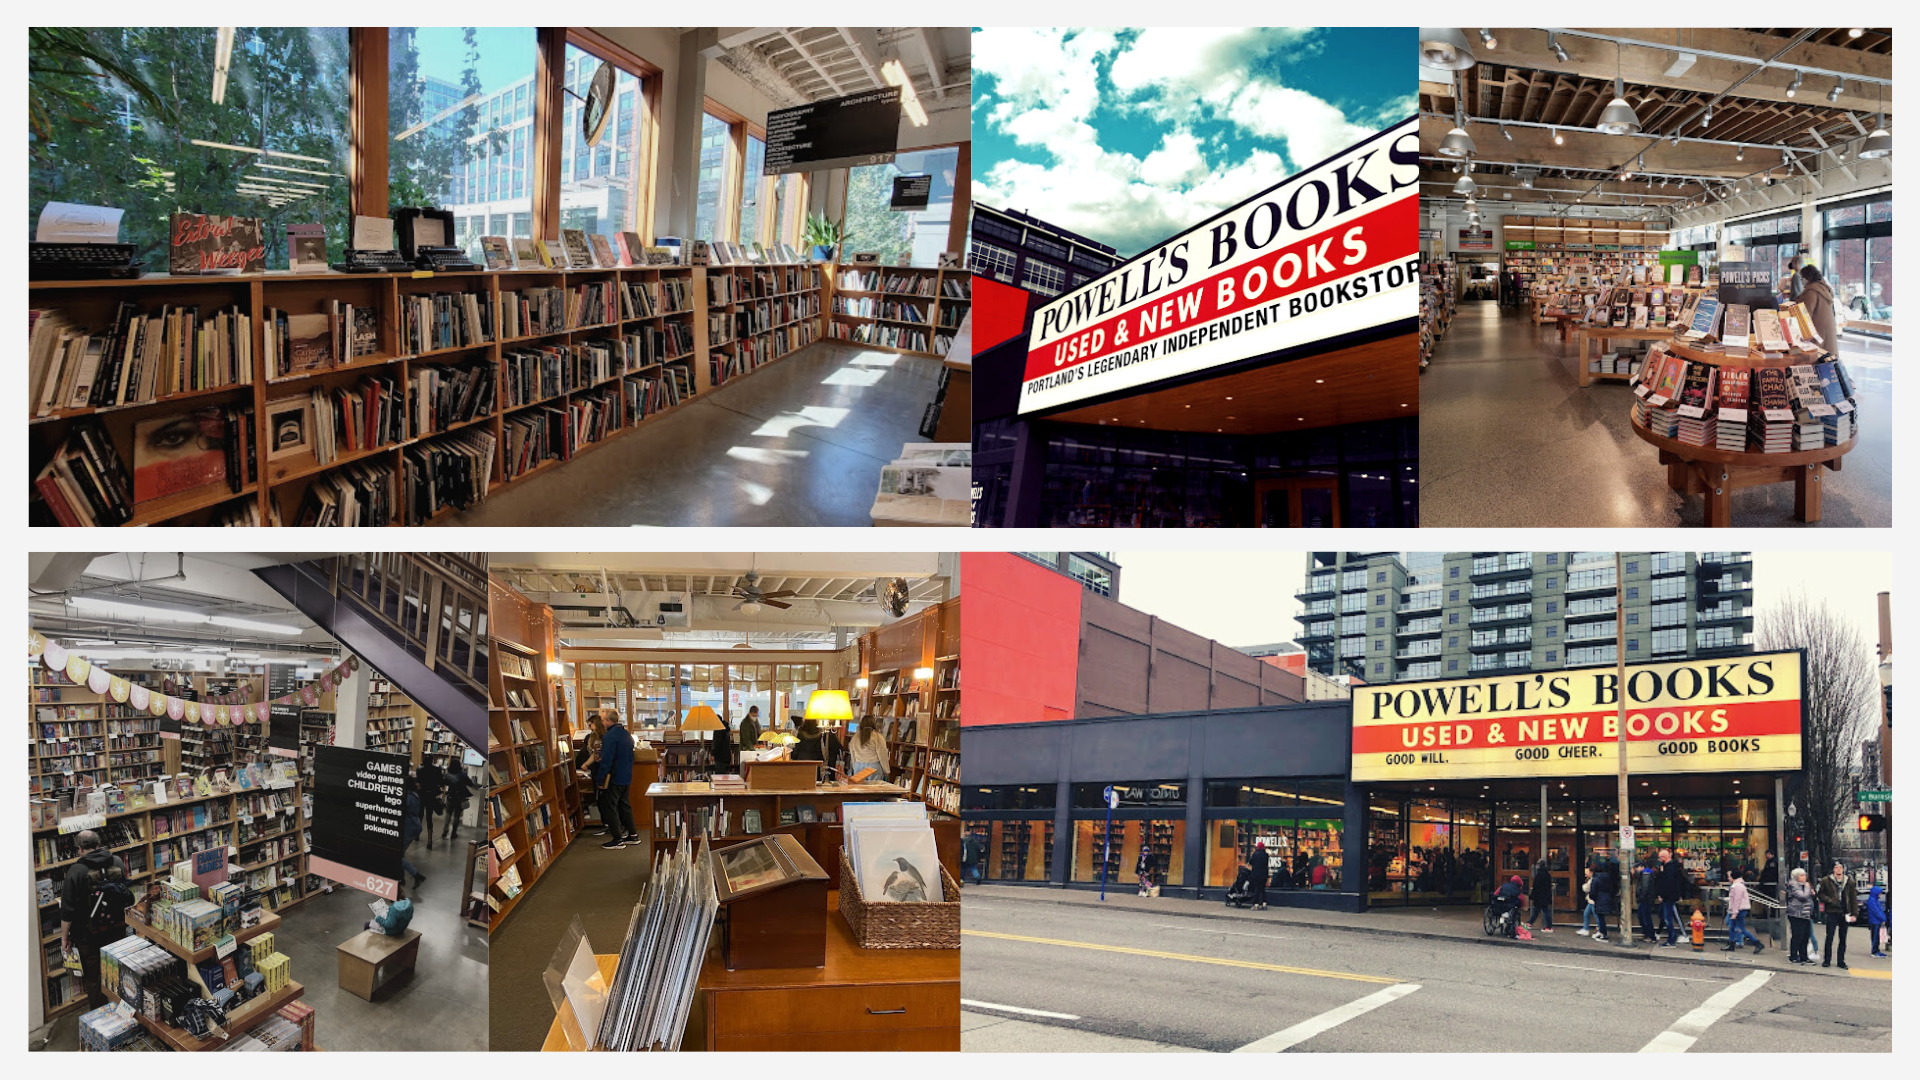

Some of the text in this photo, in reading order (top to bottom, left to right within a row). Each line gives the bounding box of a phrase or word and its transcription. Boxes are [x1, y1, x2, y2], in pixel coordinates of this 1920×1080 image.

[840, 90, 898, 107] ARCHITECTURE
[769, 107, 815, 120] PHOTOGRAPHY
[767, 142, 812, 153] ARCHITECTURE
[870, 154, 892, 164] 917
[172, 216, 233, 247] Extra!
[1039, 130, 1419, 342] POWELL'S BOOKS
[200, 245, 265, 270] Weegee
[1721, 270, 1771, 284] POWELL'S PICKS
[1054, 226, 1368, 367] USED & NEW BOOKS
[1028, 366, 1084, 395] PORTLAND'S
[1087, 342, 1158, 378] LEGENDARY
[1163, 303, 1281, 355] INDEPENDENT
[1762, 376, 1784, 384] FAMILY
[1762, 384, 1785, 392] CHAO
[1371, 660, 1774, 720] POWELL'S BOOKS
[1402, 708, 1729, 748] USED & NEW BOOKS
[1385, 738, 1760, 765] GOOD WILL. GOOD CHEER. GOOD BOOKS
[366, 761, 403, 775] GAMES
[356, 771, 404, 785] video games
[347, 779, 403, 796] CHILDREN'S
[384, 795, 402, 806] lego
[355, 801, 402, 817] superheroes
[364, 814, 398, 827] star wars
[363, 823, 399, 837] pokemon
[1678, 838, 1718, 850] POWELL'S
[197, 848, 224, 865] FAMILY
[197, 859, 224, 875] GAMES
[366, 876, 394, 896] 627
